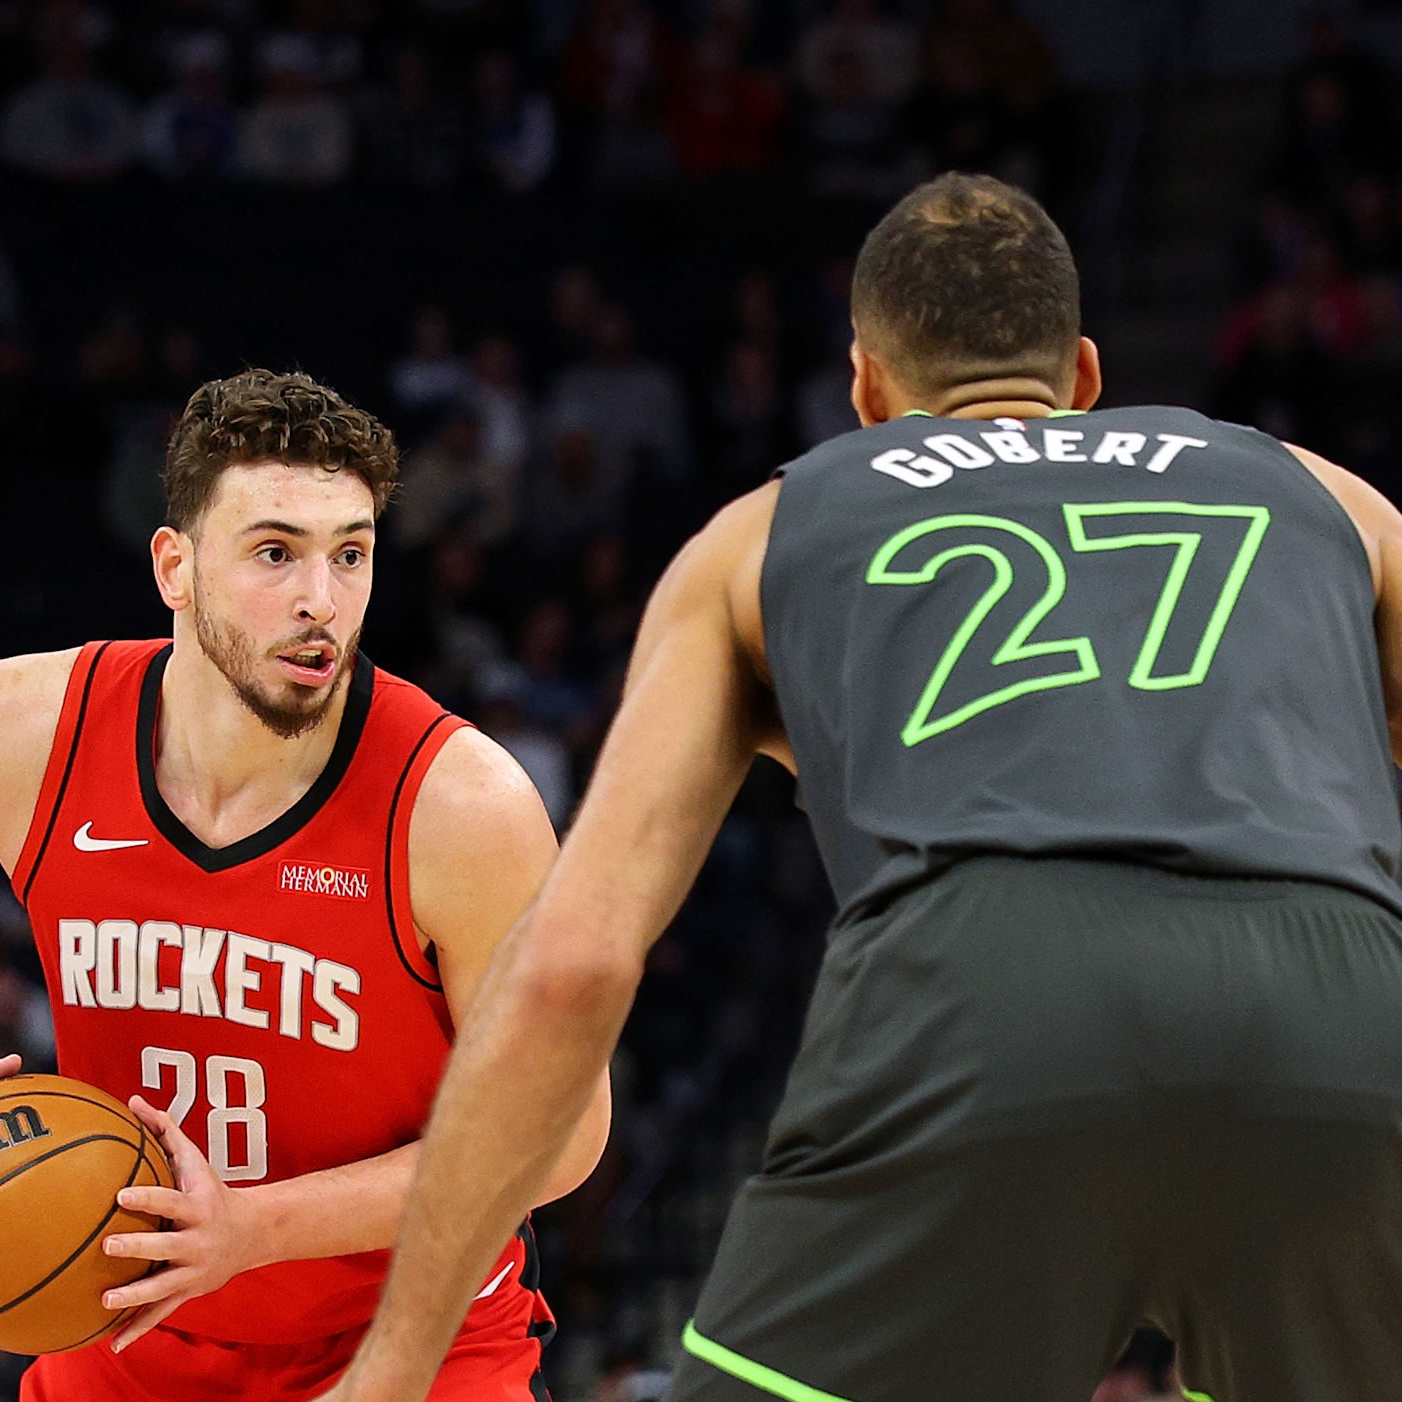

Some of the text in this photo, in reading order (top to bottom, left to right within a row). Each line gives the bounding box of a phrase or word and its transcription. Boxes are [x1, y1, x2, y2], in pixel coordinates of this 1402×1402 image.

[870, 428, 1208, 489] GOBERT
[866, 501, 1271, 748] 27
[280, 874, 369, 898] HERMANN
[281, 865, 367, 888] MEMORIAL
[58, 918, 361, 1052] ROCKETS
